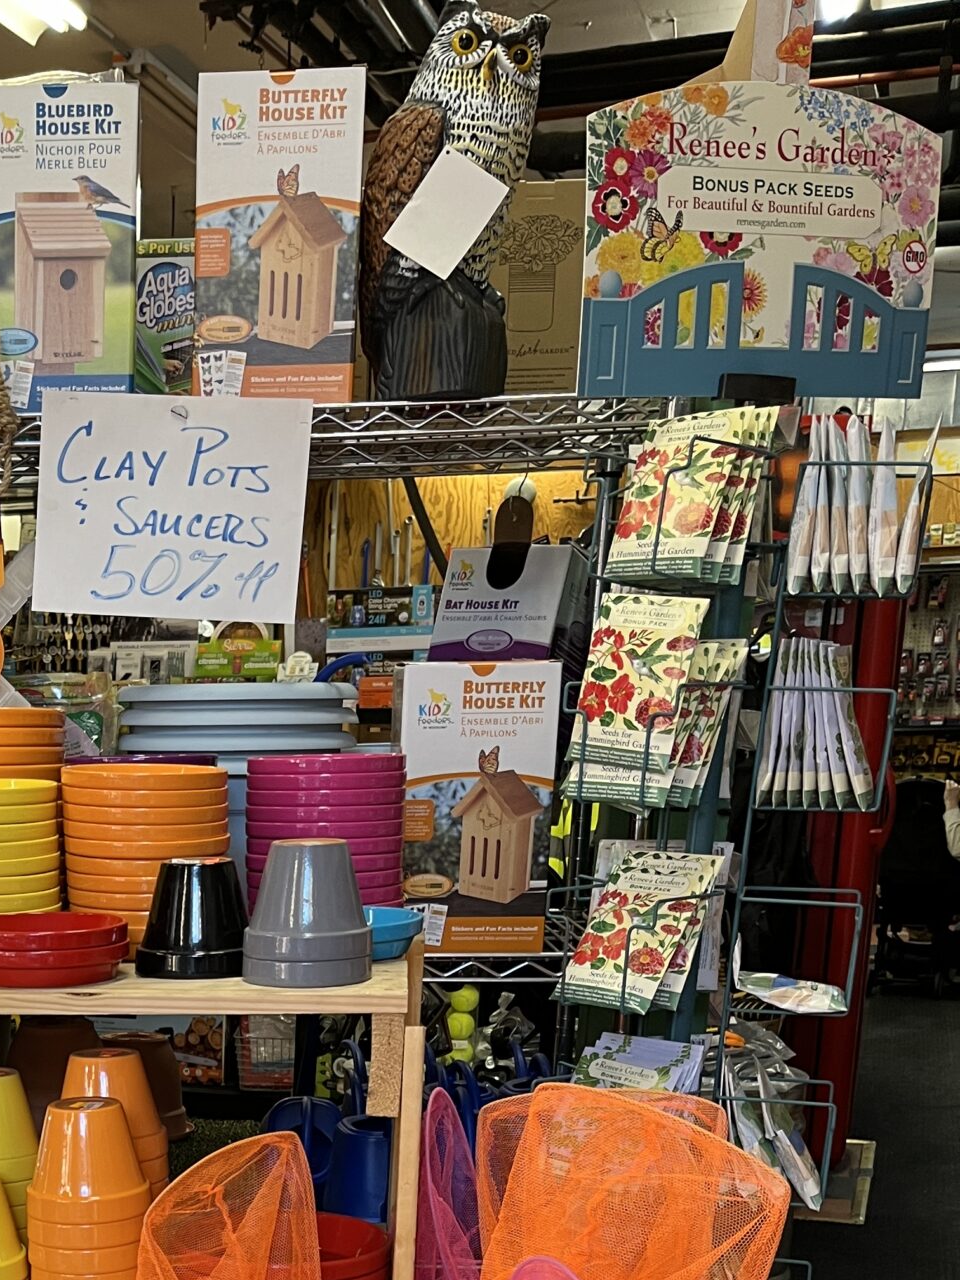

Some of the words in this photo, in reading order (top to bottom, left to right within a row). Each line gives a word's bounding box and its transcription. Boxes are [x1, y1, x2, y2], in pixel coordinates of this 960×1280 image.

[259, 87, 348, 105] BUTTERFLY
[35, 102, 114, 119] BLUEBIRD
[259, 105, 315, 122] HOUSE
[319, 103, 348, 120] KIT
[35, 119, 91, 136] HOUSE
[95, 118, 122, 135] KIT
[257, 130, 309, 142] ENSEMBLE
[35, 143, 85, 156] NICHOIR
[89, 142, 122, 155] POUR
[267, 144, 319, 155] PAPILLONS
[667, 120, 767, 160] Renee's
[777, 126, 878, 168] Garden
[35, 157, 74, 170] MERLE
[77, 156, 108, 169] BLEU
[692, 175, 750, 193] BONUS
[754, 178, 798, 197] PACK
[803, 181, 855, 199] SEEDS
[667, 195, 689, 210] For
[692, 196, 748, 212] Beautiful
[751, 199, 764, 212] &
[768, 200, 824, 216] Bountiful
[827, 203, 876, 219] Gardens
[736, 217, 807, 230] reneesgarden.com
[149, 241, 172, 255] Por
[905, 250, 925, 265] GMO
[143, 265, 191, 300] Aqua
[136, 290, 196, 328] Globes
[56, 420, 168, 487] CLAY
[180, 426, 271, 494] POTS
[112, 495, 271, 549] SAUCERS
[637, 541, 654, 549] Seed
[616, 549, 666, 560] Hummingrd
[667, 547, 695, 556] Garden
[89, 544, 229, 602] 50%
[444, 599, 464, 610] BAT
[465, 599, 500, 610] HOUSE
[502, 599, 520, 609] KIT
[463, 680, 547, 694] BUTTERFLY
[462, 695, 515, 710] HOUSE
[519, 693, 546, 709] KIT
[461, 716, 509, 726] ENSEMBLE
[469, 728, 518, 738] PAPILLONS
[601, 728, 620, 738] Seeds
[621, 729, 633, 739] for
[632, 739, 660, 751] Garen
[632, 773, 661, 785] Gden
[629, 883, 652, 891] BONUS
[616, 981, 644, 994] Grden
[600, 1071, 623, 1082] BONUS
